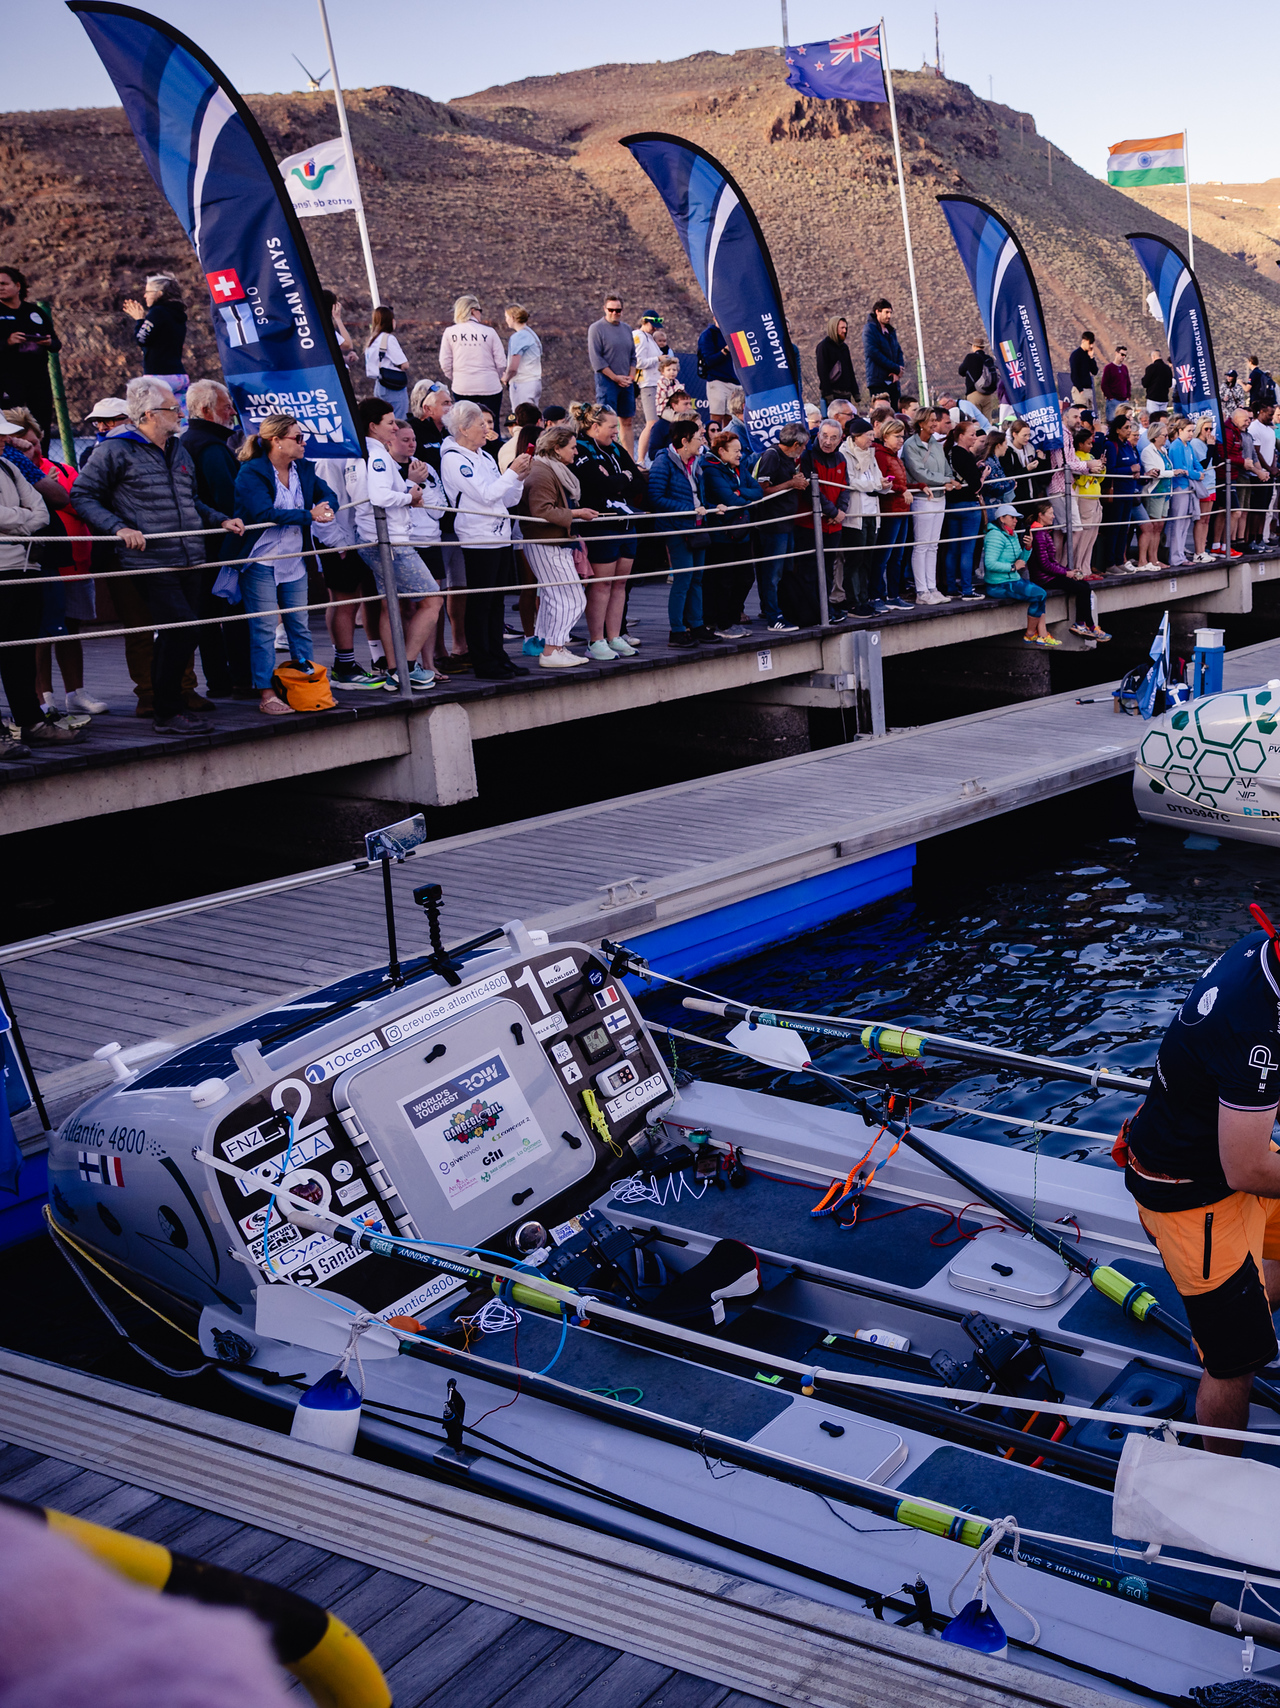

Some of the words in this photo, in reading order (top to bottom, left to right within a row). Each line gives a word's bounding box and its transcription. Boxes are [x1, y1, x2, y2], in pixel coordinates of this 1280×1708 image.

[266, 236, 296, 291] WAYS
[246, 286, 269, 325] SOLO
[285, 291, 315, 350] OCEAN
[1018, 304, 1034, 341] ODYSSEY
[1188, 309, 1204, 356] ROCKETMAN
[452, 334, 488, 342] DKNY
[746, 331, 762, 362] SOLO
[760, 312, 788, 369] ALL4ONE
[1029, 343, 1046, 382] ATLANTIC
[1198, 357, 1211, 396] ATLANTIC
[245, 400, 338, 418] TOUGHEST
[247, 388, 329, 406] WORLD'S
[747, 410, 802, 430] TOUGHES
[748, 400, 800, 420] WORLD'S
[1020, 406, 1054, 420] WORLD'S
[1026, 413, 1058, 428] OUGHEST
[762, 656, 768, 666] 37
[1166, 803, 1230, 822] DTD5947C
[546, 968, 577, 986] MOONLIGHT
[514, 965, 552, 1016] 1
[402, 975, 508, 1033] crevoise.atlantic4800
[789, 1022, 815, 1032] concept
[823, 1028, 851, 1038] SKINNY
[326, 1038, 381, 1071] 1Ocean
[458, 1064, 501, 1092] ROW
[412, 1089, 450, 1113] WORLD'S
[416, 1092, 459, 1120] TOUGHEST
[607, 1100, 622, 1114] LE
[625, 1075, 662, 1102] CORD
[271, 1078, 329, 1144] 2
[60, 1118, 105, 1148] Atlantic
[108, 1125, 146, 1154] 4800
[500, 1120, 525, 1137] concept
[226, 1131, 263, 1158] FNZ
[449, 1145, 481, 1168] givewheel
[482, 1149, 504, 1166] Gill
[398, 1248, 430, 1263] SKINNY
[438, 1260, 470, 1274] concept
[1055, 1565, 1096, 1583] concept
